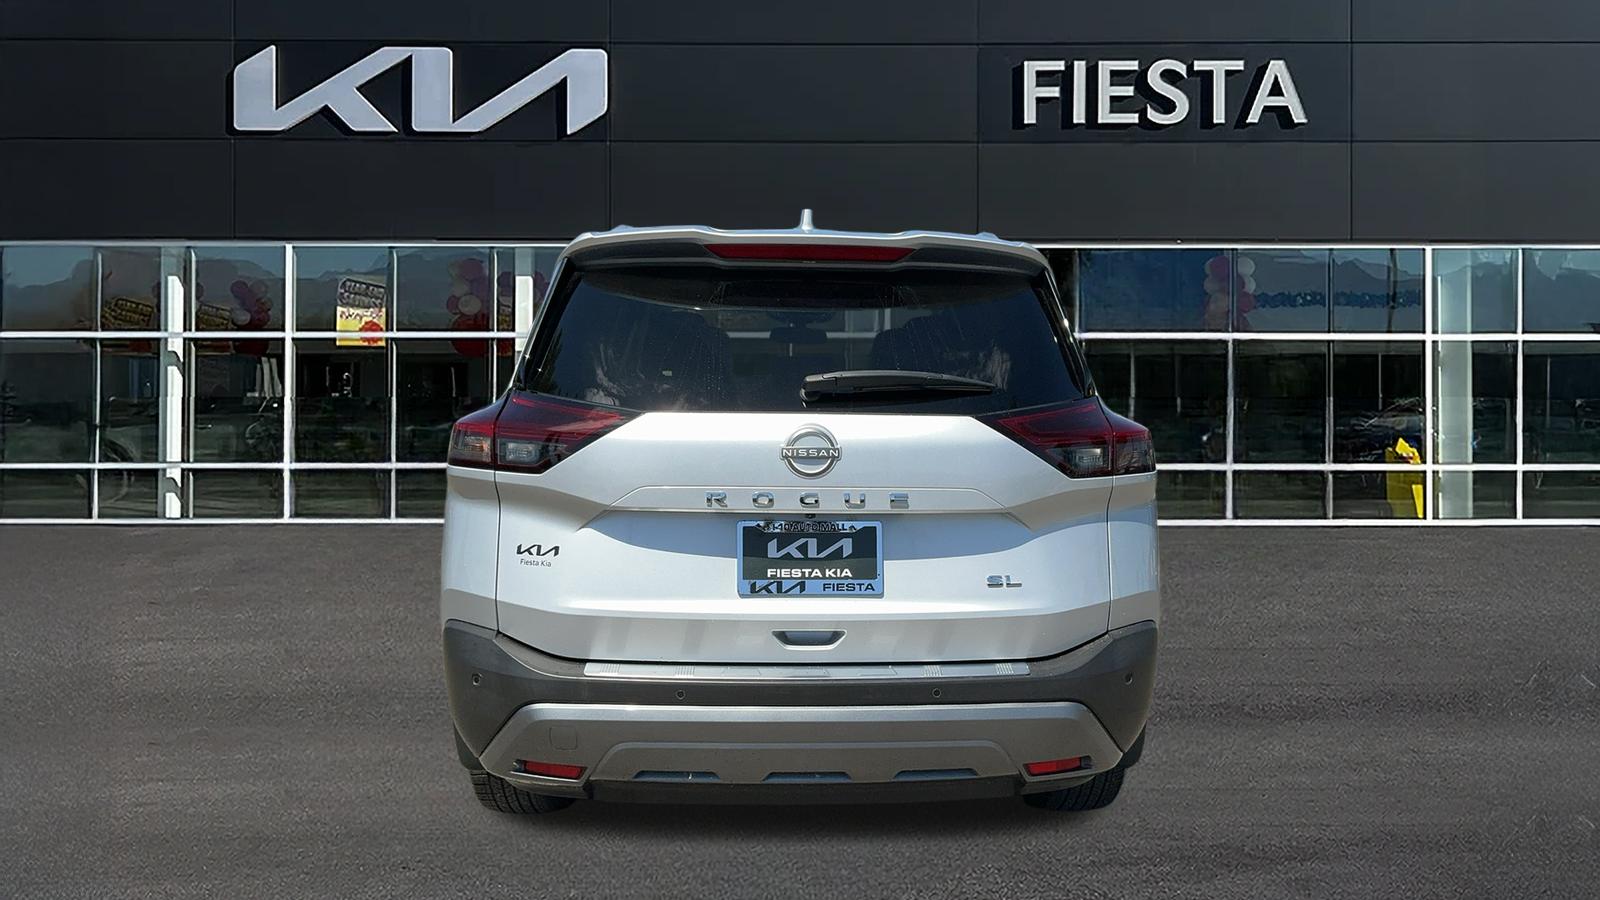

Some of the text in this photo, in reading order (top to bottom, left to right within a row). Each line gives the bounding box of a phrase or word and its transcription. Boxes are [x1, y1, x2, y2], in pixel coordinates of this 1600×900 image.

[233, 44, 609, 135] KIA
[1023, 58, 1309, 125] FIESTA
[782, 448, 839, 457] NISSAN
[705, 491, 910, 509] ROGUE
[791, 521, 819, 531] AUTO
[820, 521, 848, 531] MALL
[516, 543, 560, 557] KIA
[767, 537, 853, 559] KIA
[520, 558, 540, 566] Fiesta
[767, 568, 853, 578] FIESTA KIA
[750, 580, 806, 594] KIA
[822, 583, 876, 592] FIESTA
[986, 575, 1023, 588] SL
